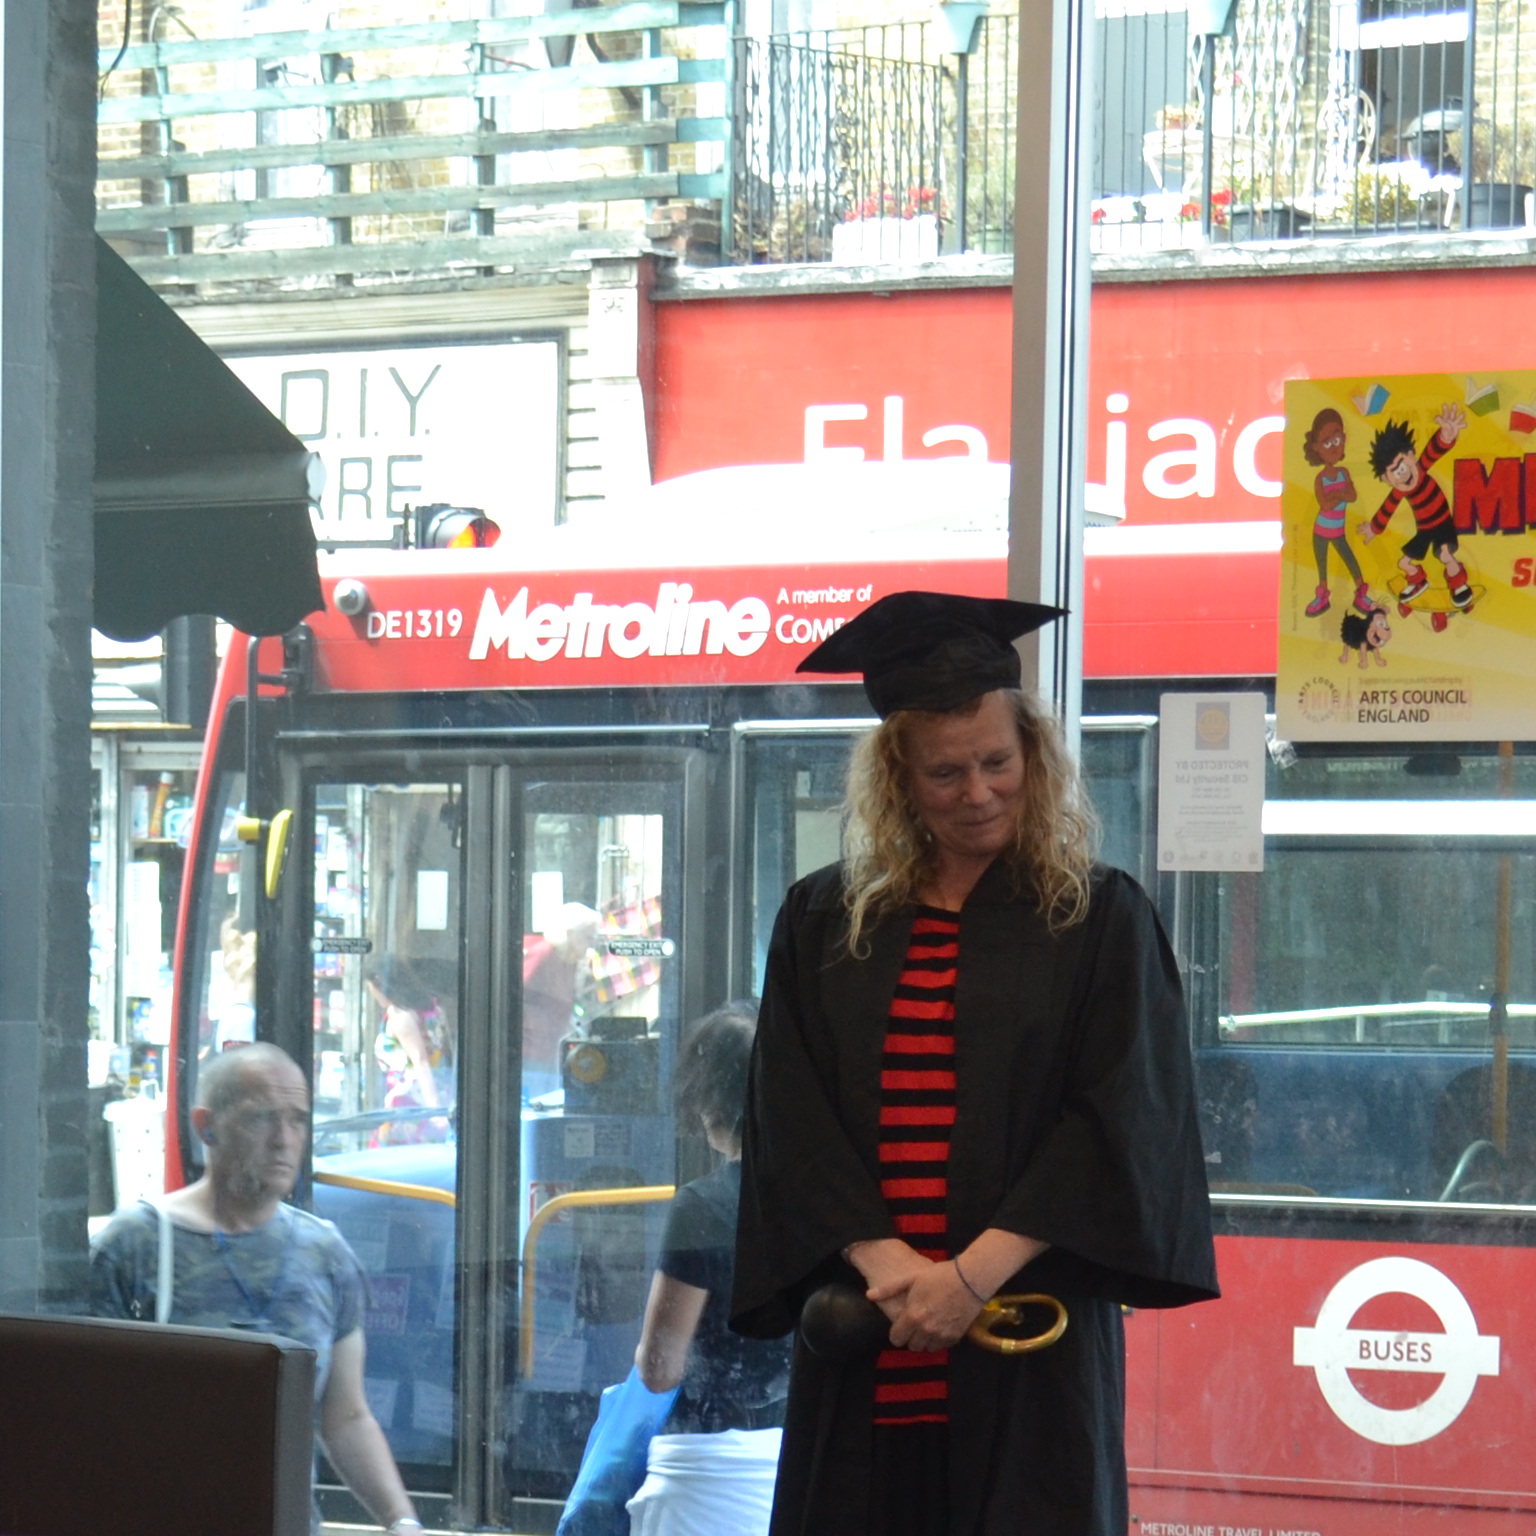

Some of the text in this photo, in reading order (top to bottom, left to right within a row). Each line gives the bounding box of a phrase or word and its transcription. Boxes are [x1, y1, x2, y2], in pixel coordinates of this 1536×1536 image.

[307, 454, 425, 522] RE
[777, 584, 873, 605] A member of
[367, 608, 463, 640] DE1319
[469, 582, 772, 662] Metroline
[1359, 690, 1467, 706] ARTS COUNCIL
[1358, 709, 1430, 723] ENGLAND
[1358, 1339, 1432, 1364] BUSES
